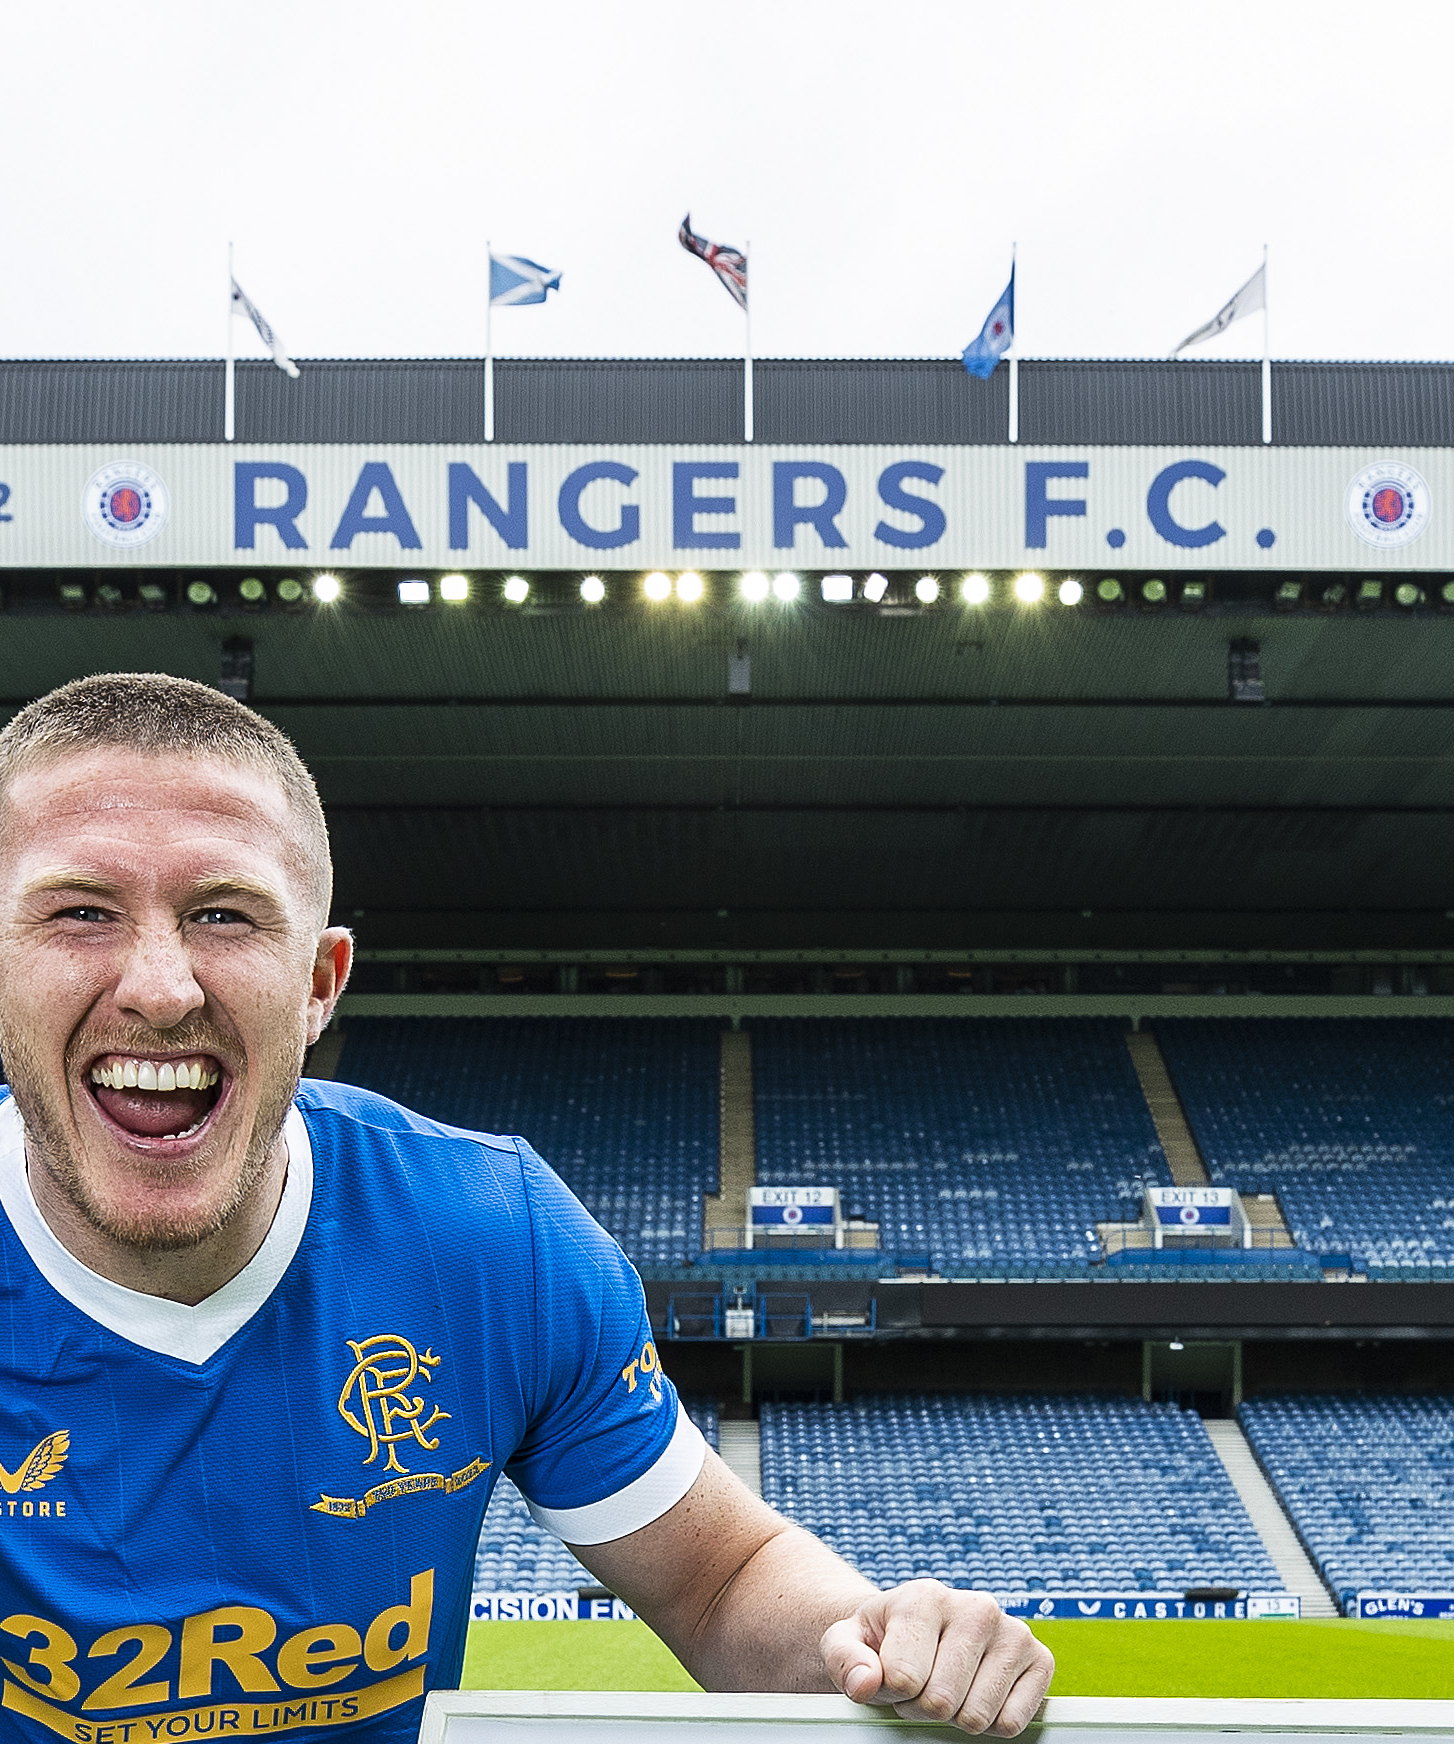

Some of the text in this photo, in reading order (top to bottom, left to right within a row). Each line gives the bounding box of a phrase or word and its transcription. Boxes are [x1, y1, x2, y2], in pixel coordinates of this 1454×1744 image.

[234, 459, 1276, 551] RANGERS F.C.
[762, 1191, 822, 1203] EXIT 12
[1161, 1191, 1220, 1203] EXIT 13
[622, 1341, 662, 1393] TO
[470, 1598, 643, 1620] CISION EN
[1113, 1601, 1245, 1618] CASTORE
[1365, 1598, 1425, 1616] GLEN'S
[0, 1568, 435, 1710] 32Red
[145, 1710, 240, 1740] YOUR
[253, 1696, 360, 1729] LIMITS
